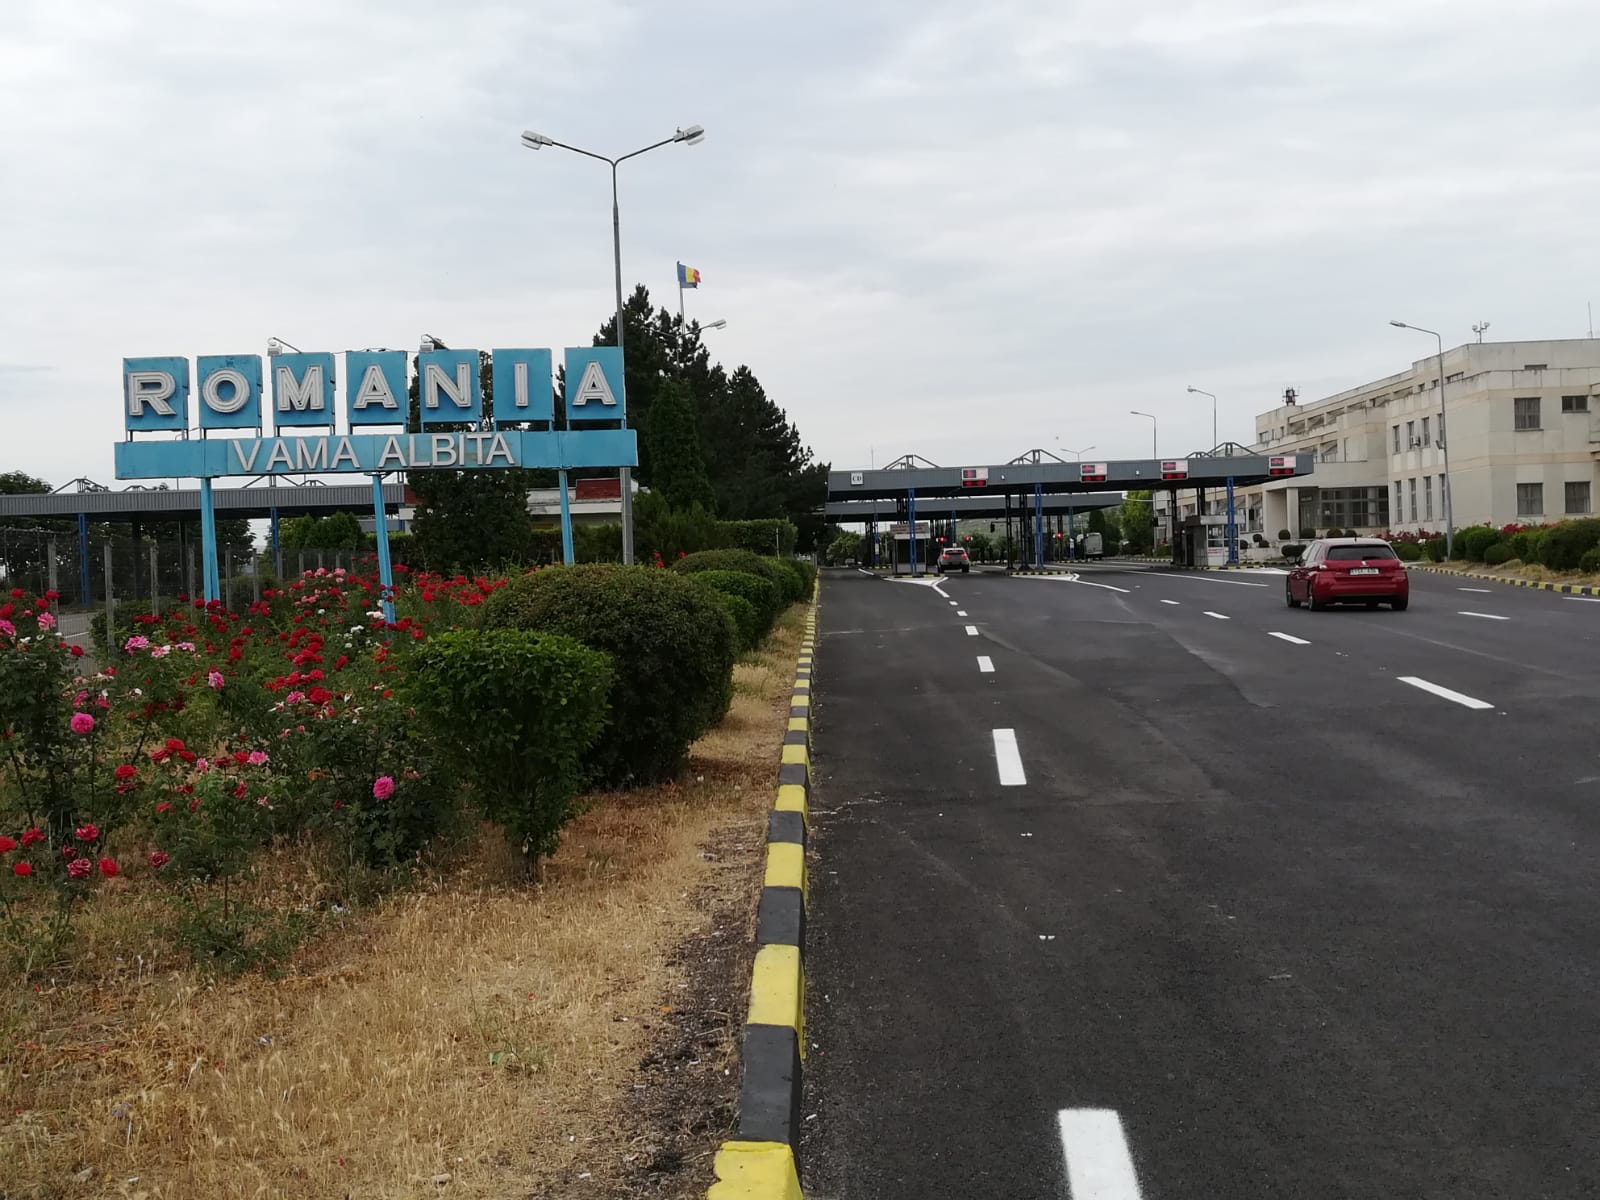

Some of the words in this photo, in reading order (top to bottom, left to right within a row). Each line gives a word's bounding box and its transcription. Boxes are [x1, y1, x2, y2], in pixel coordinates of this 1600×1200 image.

[127, 360, 617, 417] ROMANIA
[232, 436, 360, 472] VAMA
[378, 432, 515, 468] ALBITA
